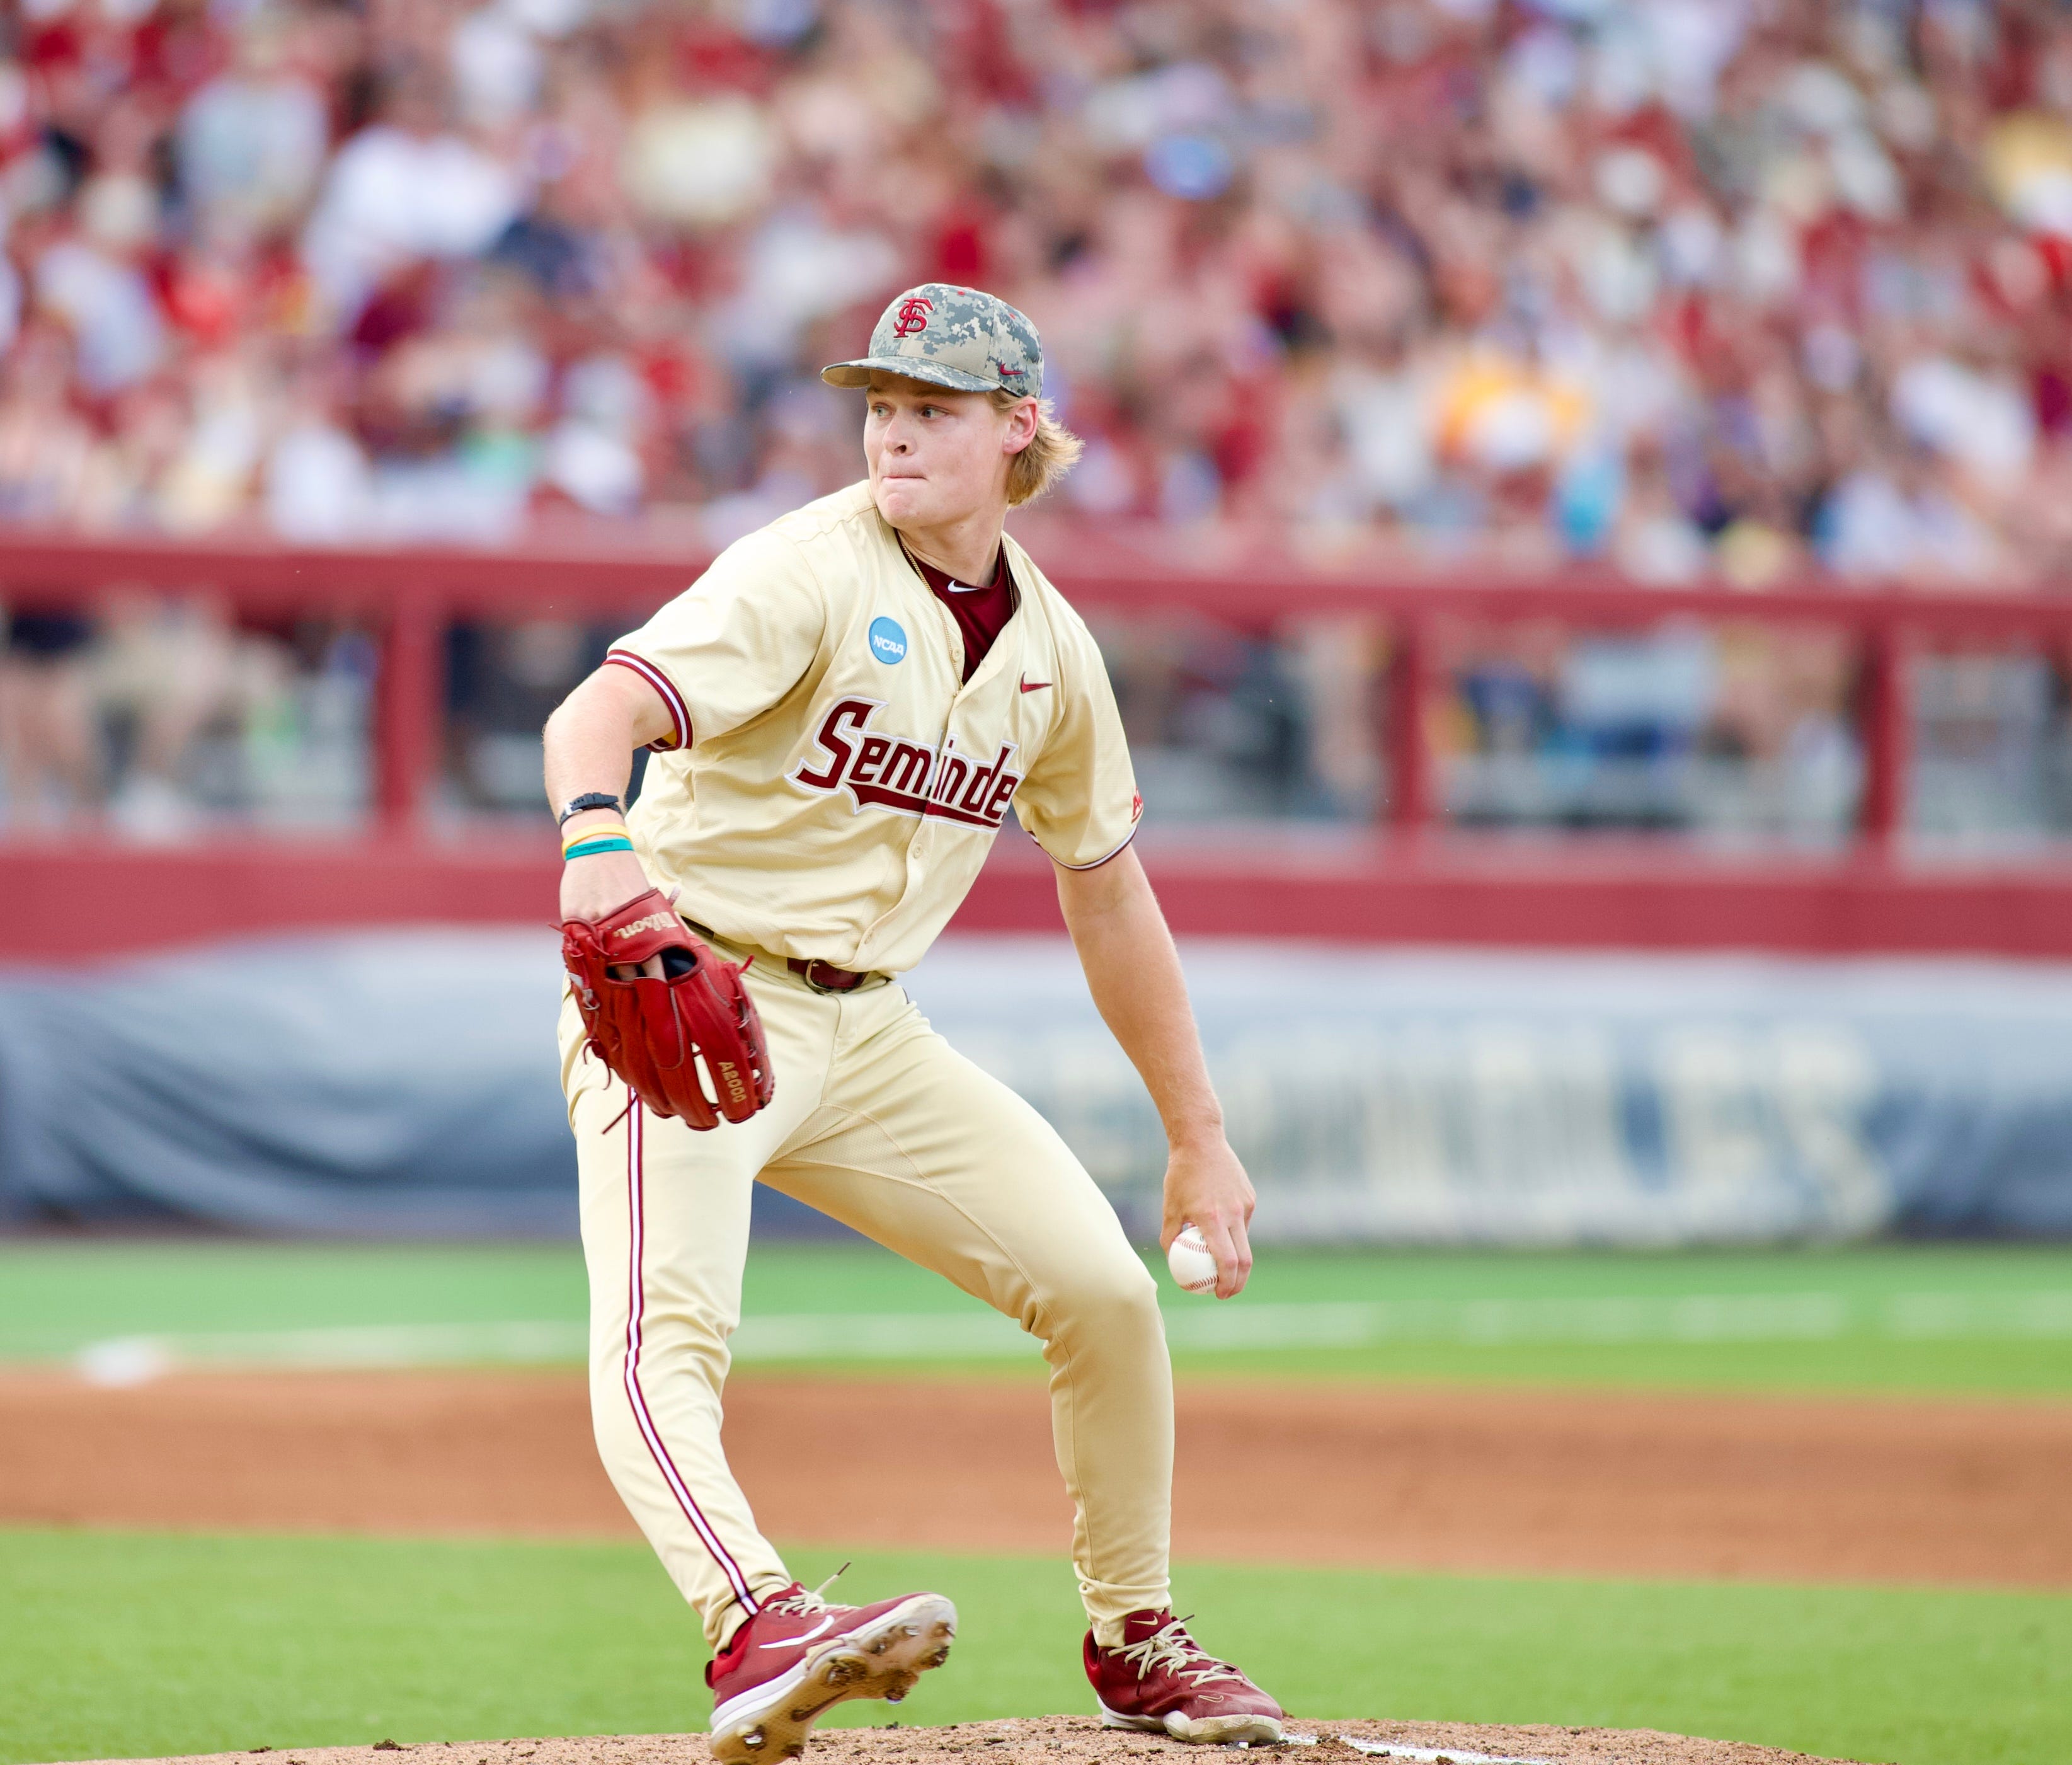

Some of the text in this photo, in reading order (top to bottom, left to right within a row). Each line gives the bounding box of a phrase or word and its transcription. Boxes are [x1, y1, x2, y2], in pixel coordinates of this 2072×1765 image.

[874, 635, 904, 656] NCAA
[785, 695, 1025, 823] Seminole
[718, 1062, 747, 1103] A2000
